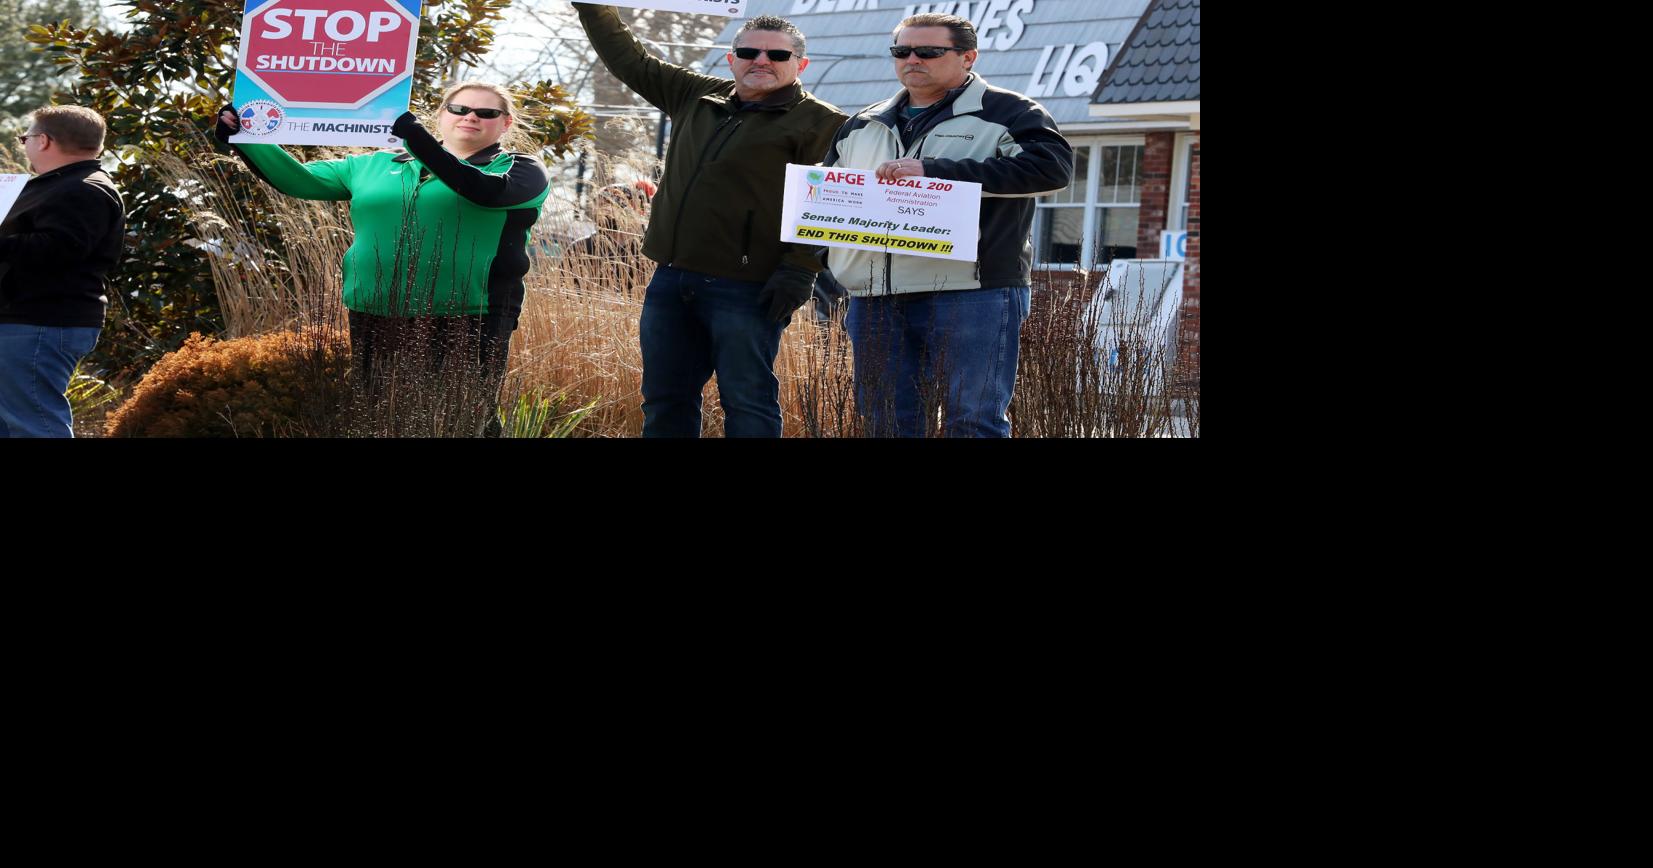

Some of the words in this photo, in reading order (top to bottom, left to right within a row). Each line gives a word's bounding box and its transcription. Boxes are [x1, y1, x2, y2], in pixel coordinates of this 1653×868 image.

[260, 8, 402, 42] STOP
[903, 0, 1036, 51] NES
[309, 41, 347, 57] THE
[255, 55, 396, 73] SHUTDOWN
[1025, 41, 1124, 98] LIQ
[287, 121, 310, 132] THE
[824, 171, 865, 186] AFGE
[877, 176, 923, 189] LOCAL
[926, 181, 953, 192] 200
[884, 188, 912, 197] Federal
[912, 191, 941, 200] Aviation
[886, 196, 938, 208] Administration
[897, 206, 925, 217] SAYS
[801, 212, 845, 224] Senate
[848, 216, 900, 231] Majority
[903, 222, 951, 235] Leader:
[797, 228, 825, 238] END
[828, 231, 859, 242] THIS
[861, 235, 939, 251] SHUTDOWN
[940, 244, 954, 253] !!!
